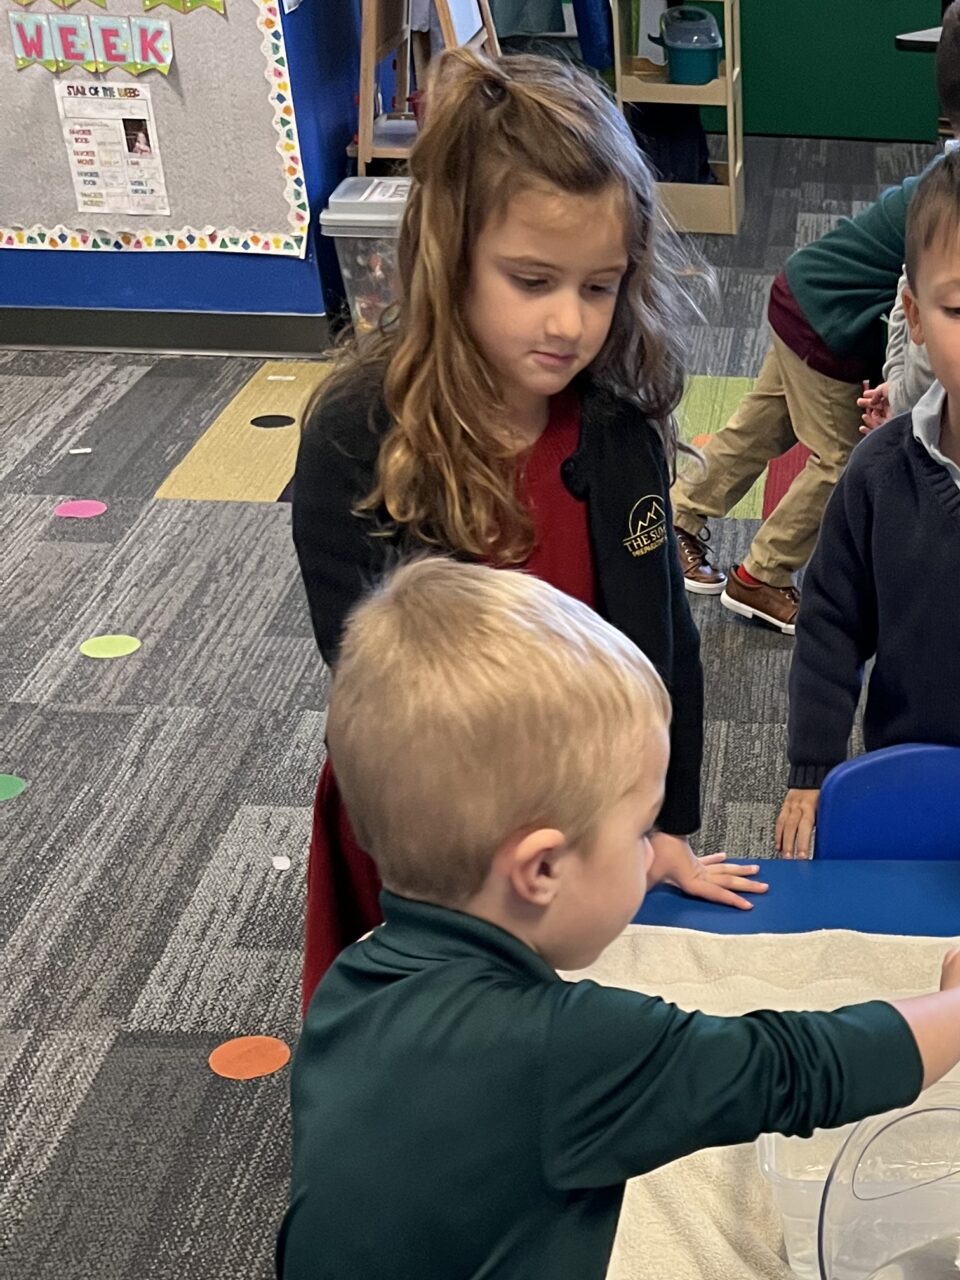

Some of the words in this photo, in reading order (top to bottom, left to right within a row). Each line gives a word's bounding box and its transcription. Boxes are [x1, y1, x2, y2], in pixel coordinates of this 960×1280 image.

[15, 22, 166, 63] WEEK
[66, 85, 87, 96] STAR
[88, 86, 100, 97] OF
[623, 534, 651, 552] THE
